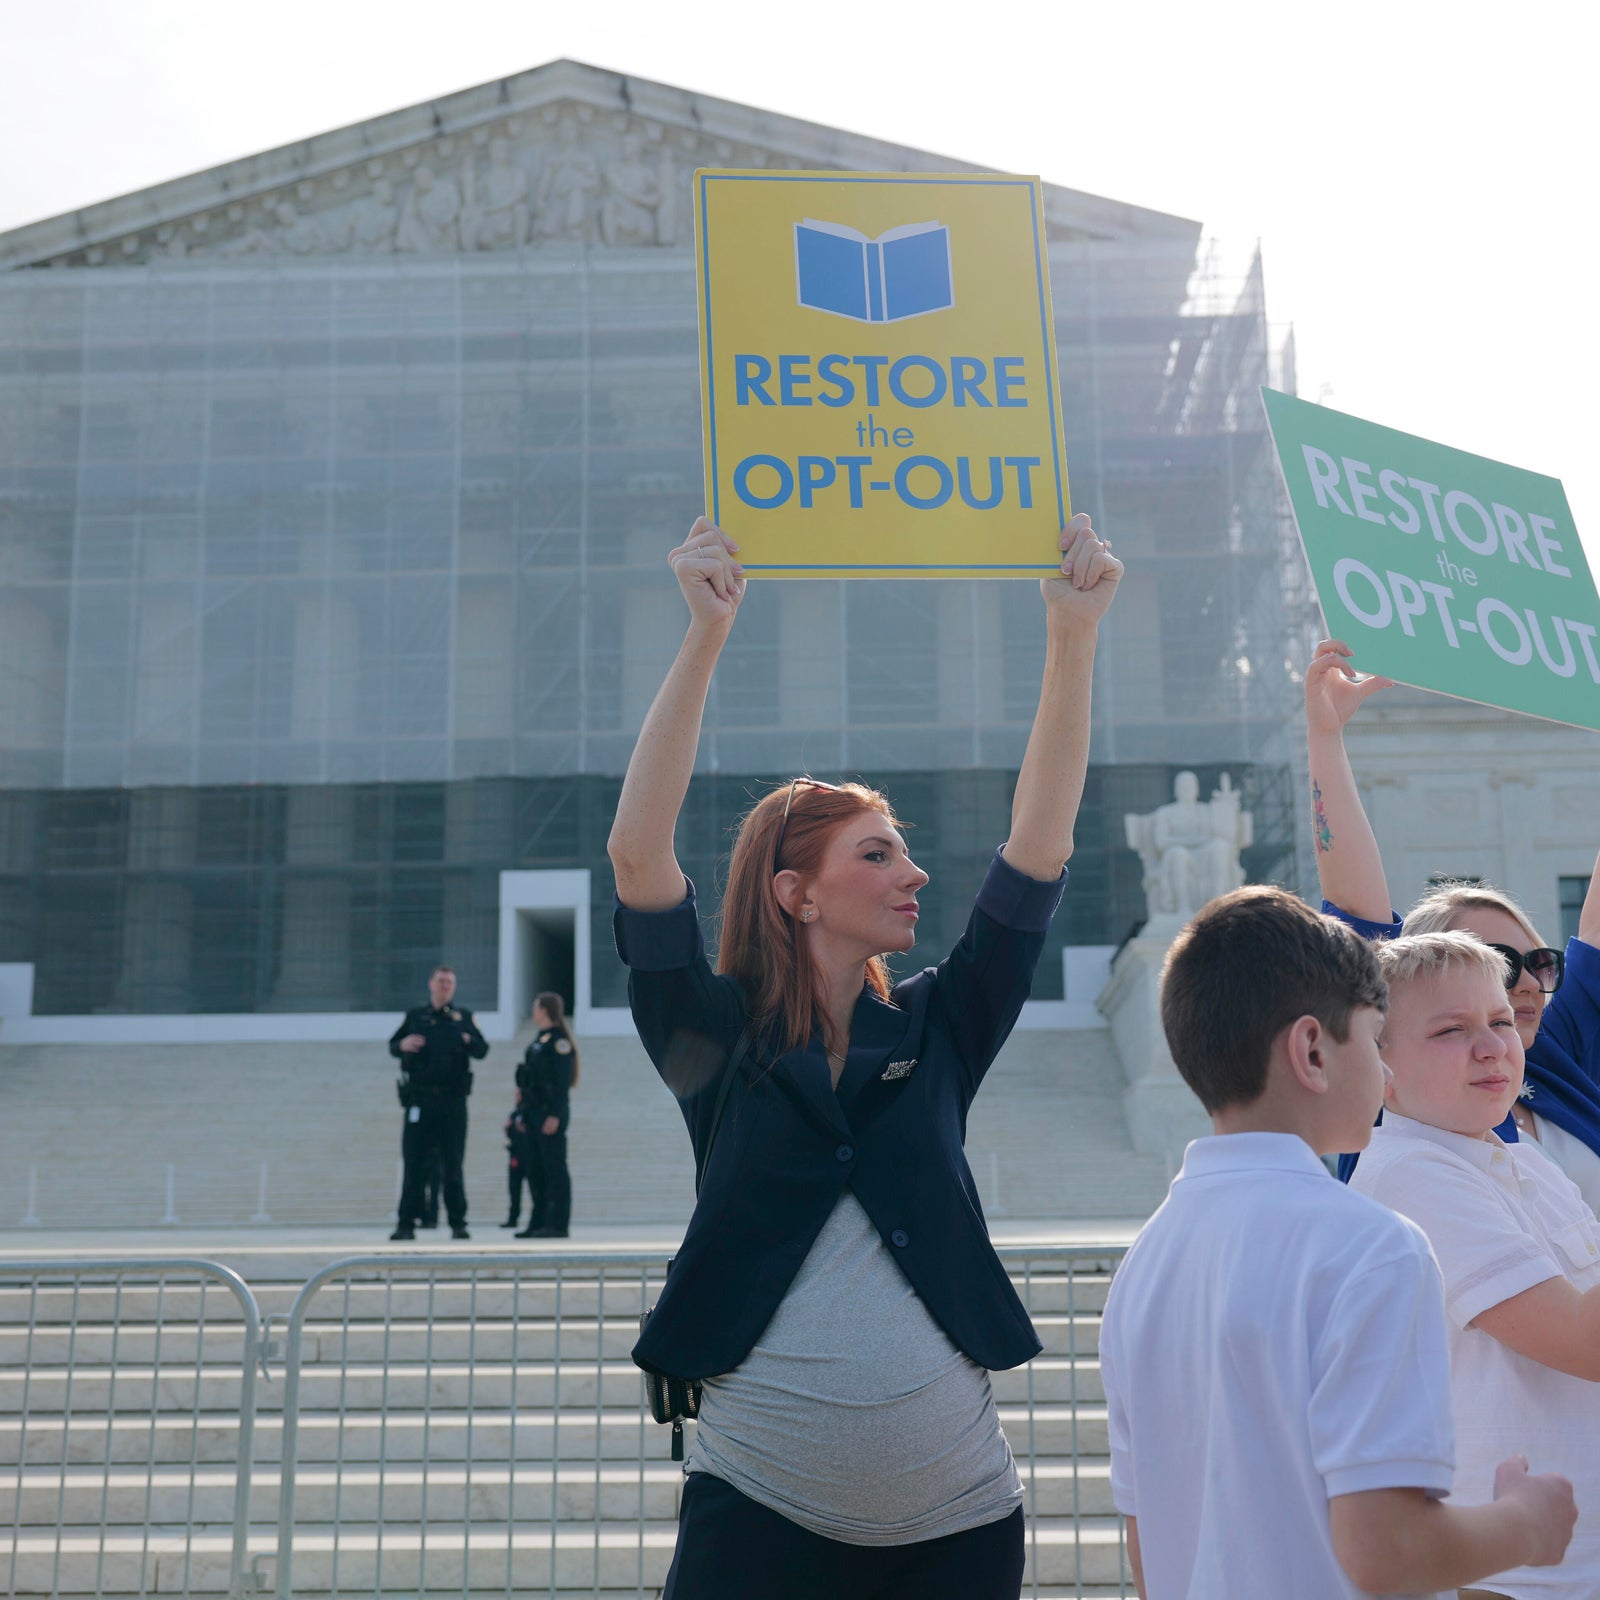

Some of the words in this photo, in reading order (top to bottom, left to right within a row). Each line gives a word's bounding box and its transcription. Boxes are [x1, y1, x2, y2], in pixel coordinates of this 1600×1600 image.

[734, 353, 1028, 408] RESTORE
[856, 413, 914, 448] the
[733, 454, 1041, 510] OPT-OUT
[1301, 443, 1572, 578] RESTORE
[1436, 549, 1478, 587] the
[1333, 557, 1600, 685] OPT-OUT
